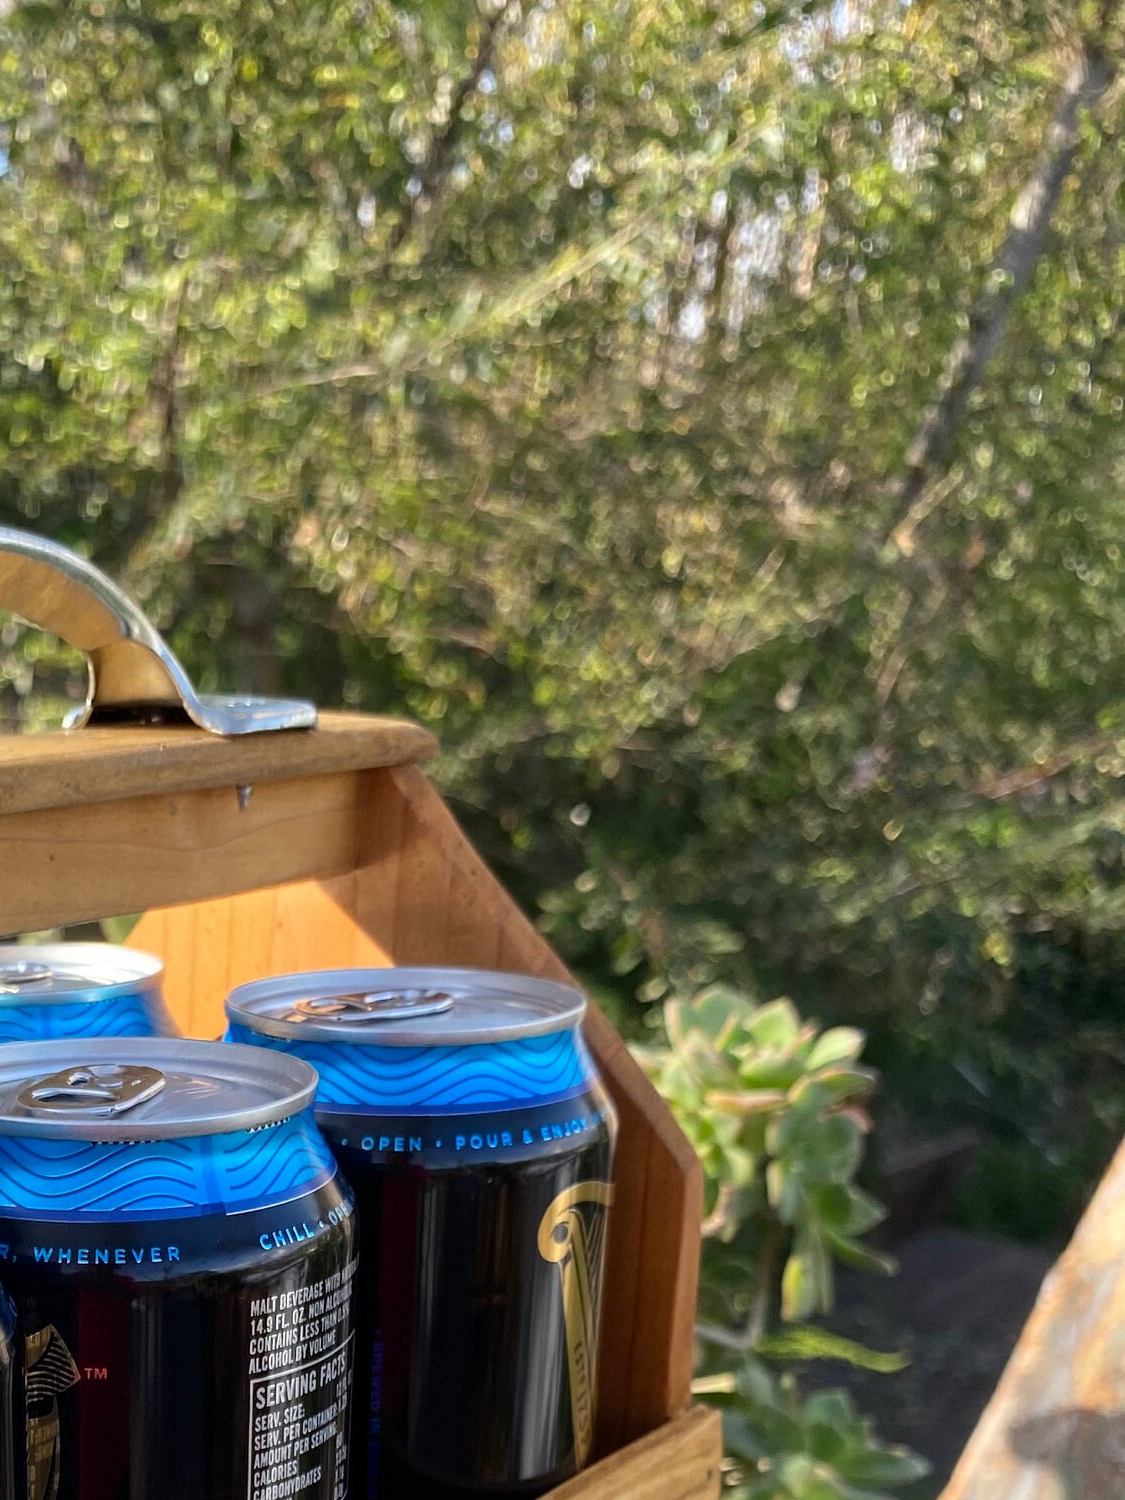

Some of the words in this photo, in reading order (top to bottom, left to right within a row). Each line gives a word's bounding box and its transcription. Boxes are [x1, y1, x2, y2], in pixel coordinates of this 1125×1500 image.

[361, 1136, 422, 1152] OPEN
[455, 1130, 514, 1151] POUR
[522, 1128, 534, 1145] &
[540, 1117, 589, 1142] ENJOY
[33, 1246, 181, 1265] WHENEVER
[259, 1221, 316, 1251] CHILL
[250, 1296, 278, 1318] MALT
[279, 1281, 324, 1311] BEVERAGE
[250, 1316, 273, 1336] 14.9
[292, 1307, 307, 1326] OZ.
[308, 1299, 325, 1319] NON
[248, 1348, 294, 1375] ALCOHOL
[295, 1343, 308, 1362] BY
[309, 1329, 336, 1357] VOLUME
[249, 1328, 298, 1356] CONTAINS
[299, 1319, 320, 1342] LESS
[84, 1366, 109, 1380] TM
[255, 1370, 317, 1410] SERVING
[319, 1352, 346, 1387] FACTS
[254, 1411, 282, 1433] SERV.
[283, 1403, 306, 1425] SIZE:
[253, 1444, 292, 1470] AMOUNT
[293, 1437, 310, 1457] PER
[254, 1429, 281, 1452] SERV.
[283, 1423, 301, 1443] PER
[253, 1460, 298, 1488] CALORIES
